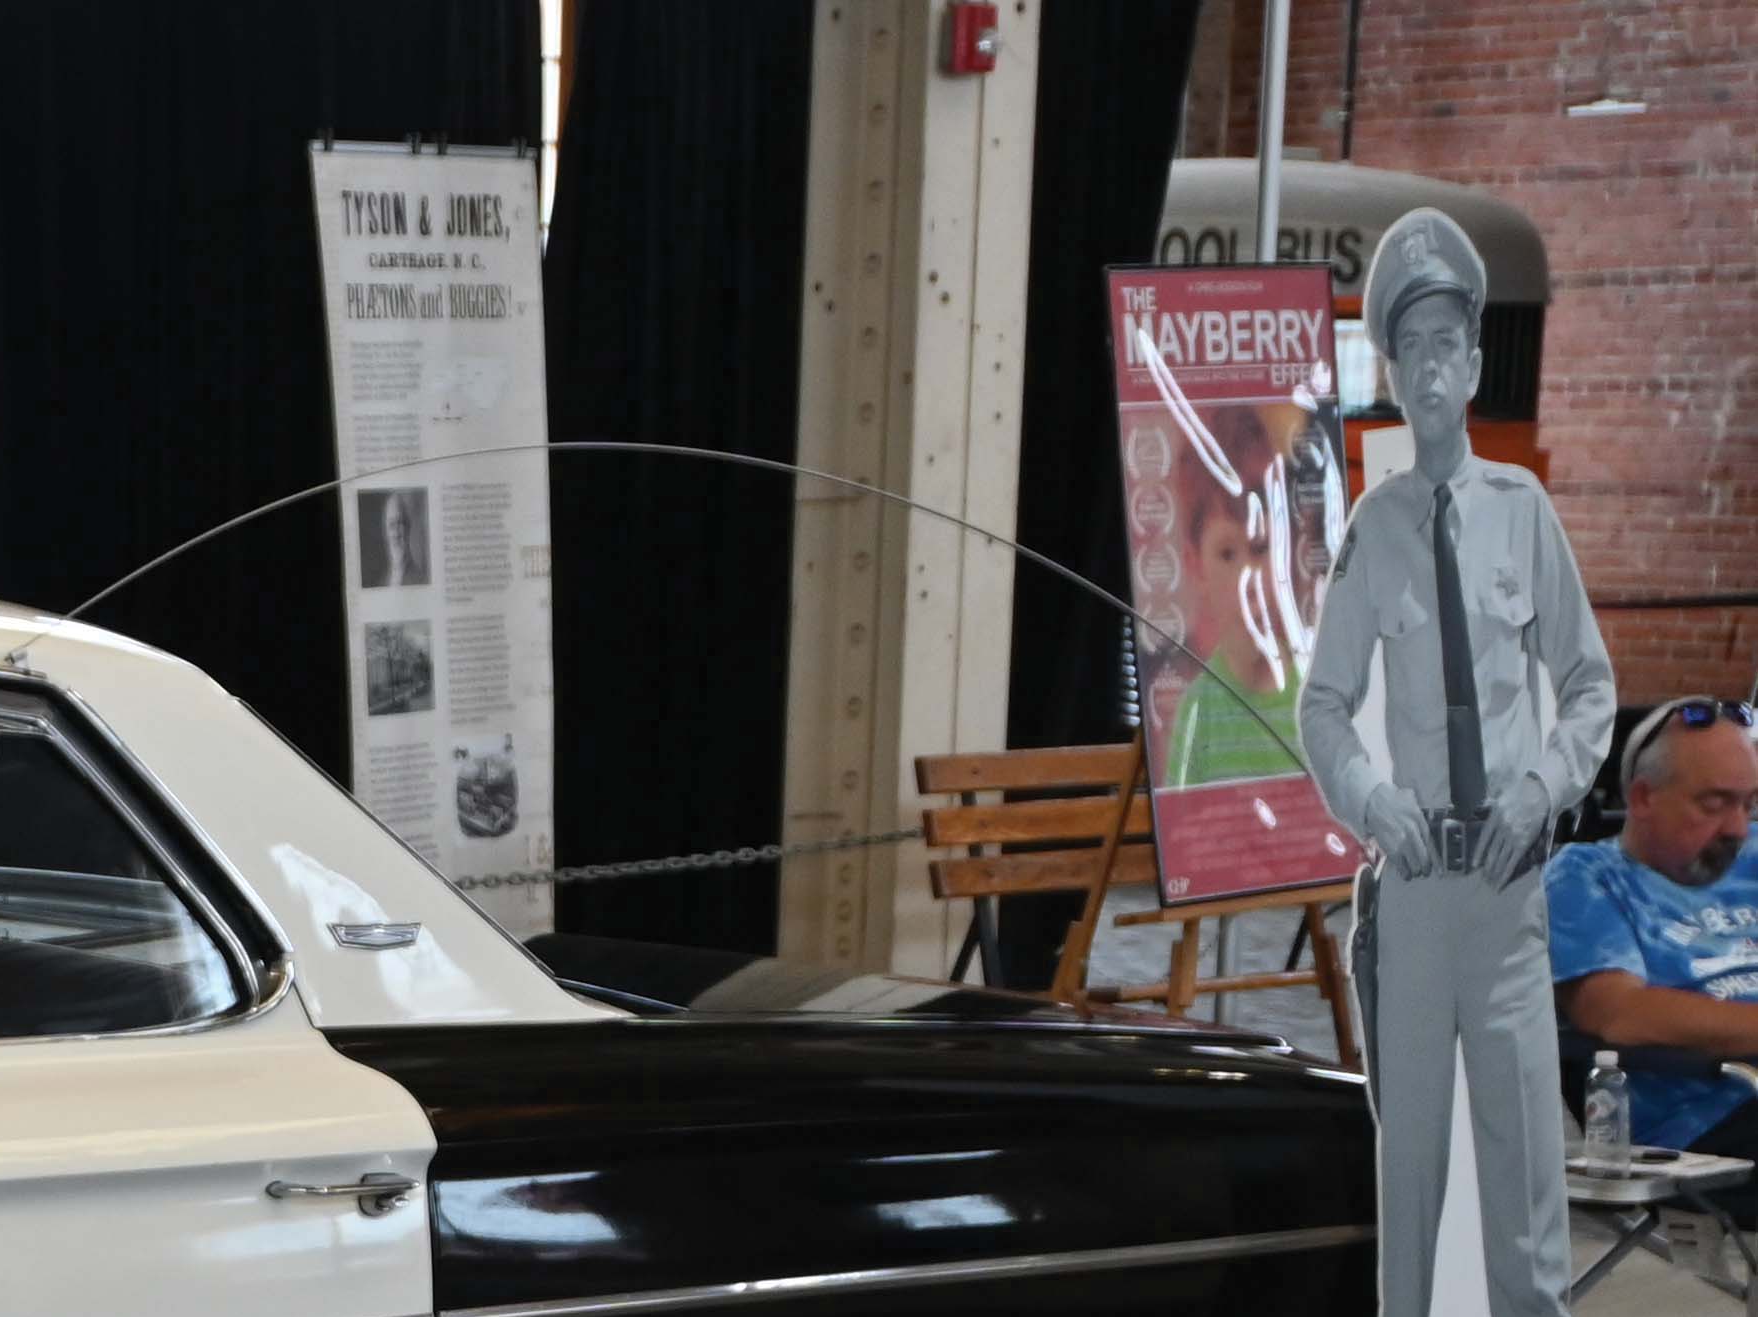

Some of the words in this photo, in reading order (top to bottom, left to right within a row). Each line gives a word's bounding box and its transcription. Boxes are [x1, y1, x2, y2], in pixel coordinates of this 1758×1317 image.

[341, 190, 408, 236] TYSON
[418, 195, 432, 237] &
[445, 193, 510, 243] JONES,
[420, 283, 443, 319] and
[449, 283, 513, 319] BUGGIES!
[1121, 286, 1156, 311] THE
[1123, 309, 1324, 366] MAYBERRY
